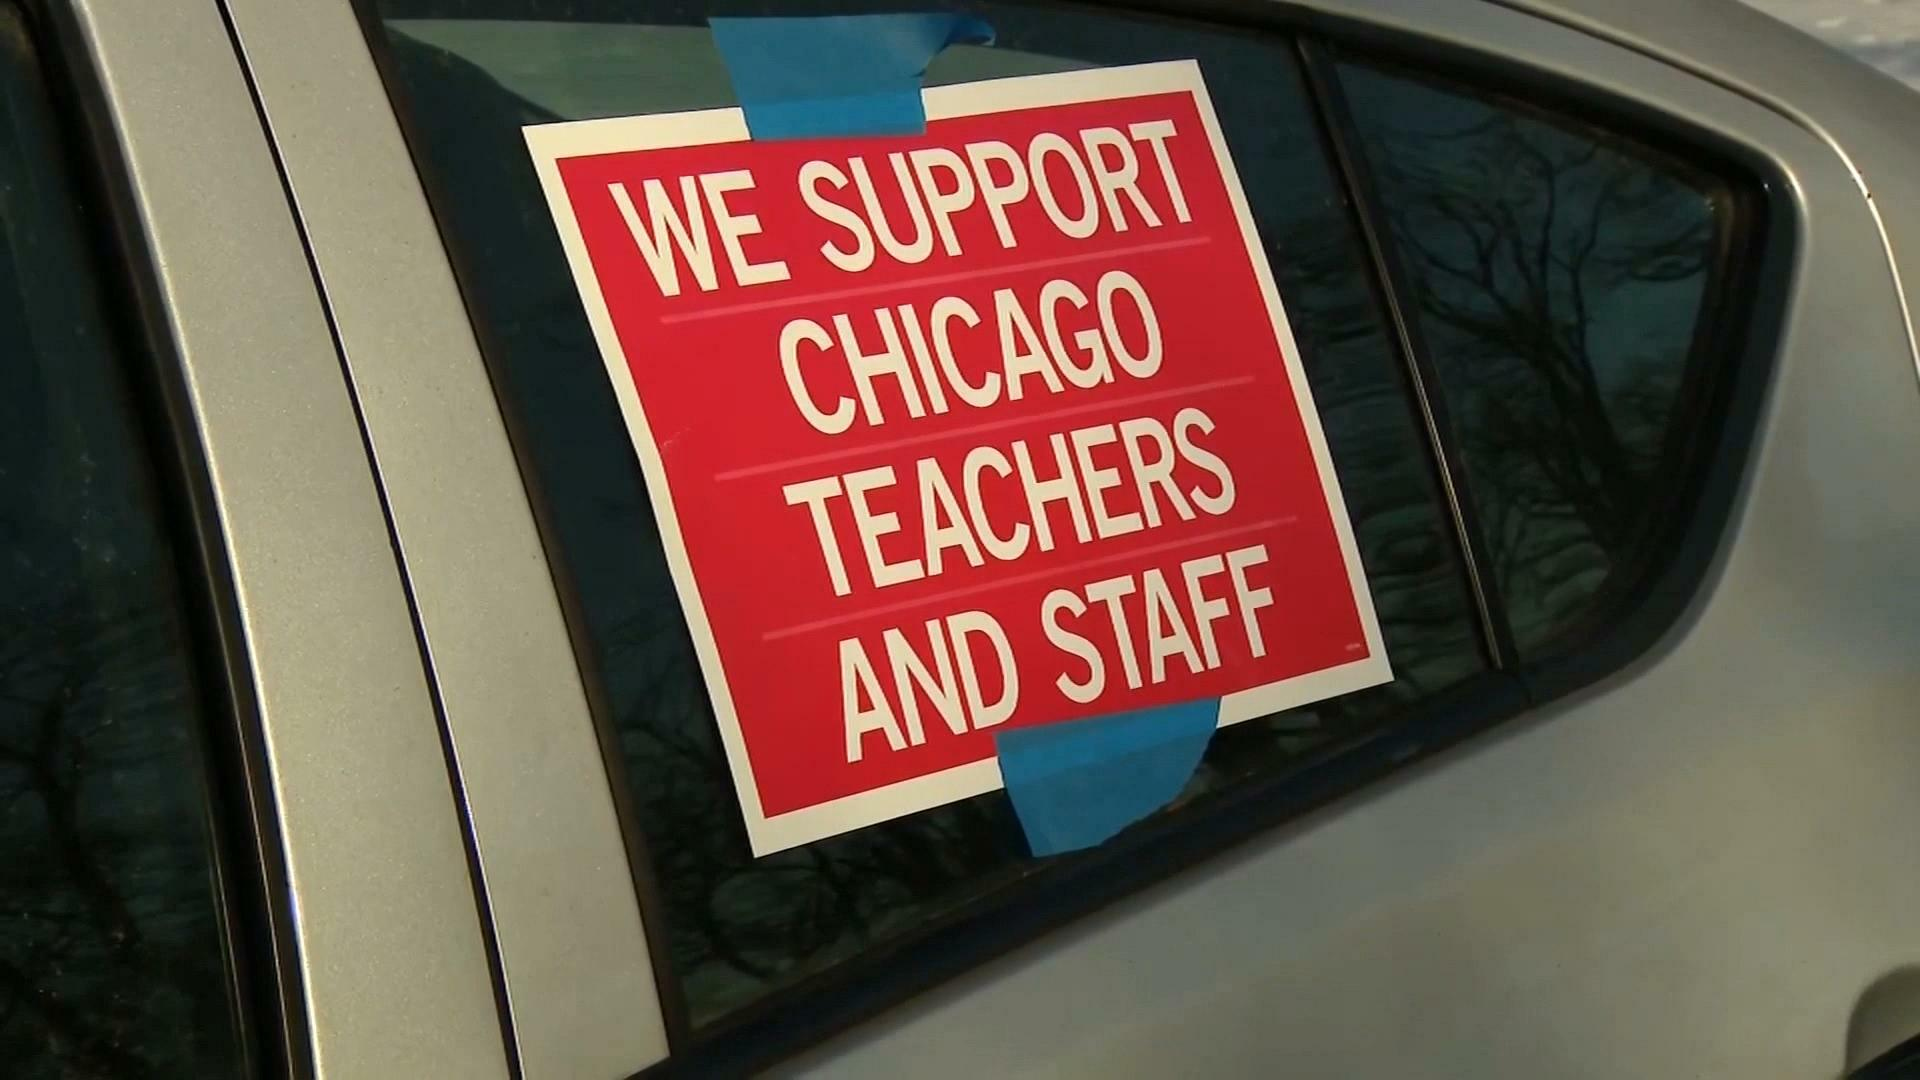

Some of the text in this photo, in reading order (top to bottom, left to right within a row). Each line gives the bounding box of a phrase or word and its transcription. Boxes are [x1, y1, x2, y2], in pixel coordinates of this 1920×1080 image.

[607, 119, 1192, 297] WE SUPPORT
[779, 270, 1163, 435] CHICAGO
[782, 407, 1236, 597] TEACHERS
[839, 544, 1274, 763] AND STAFF
